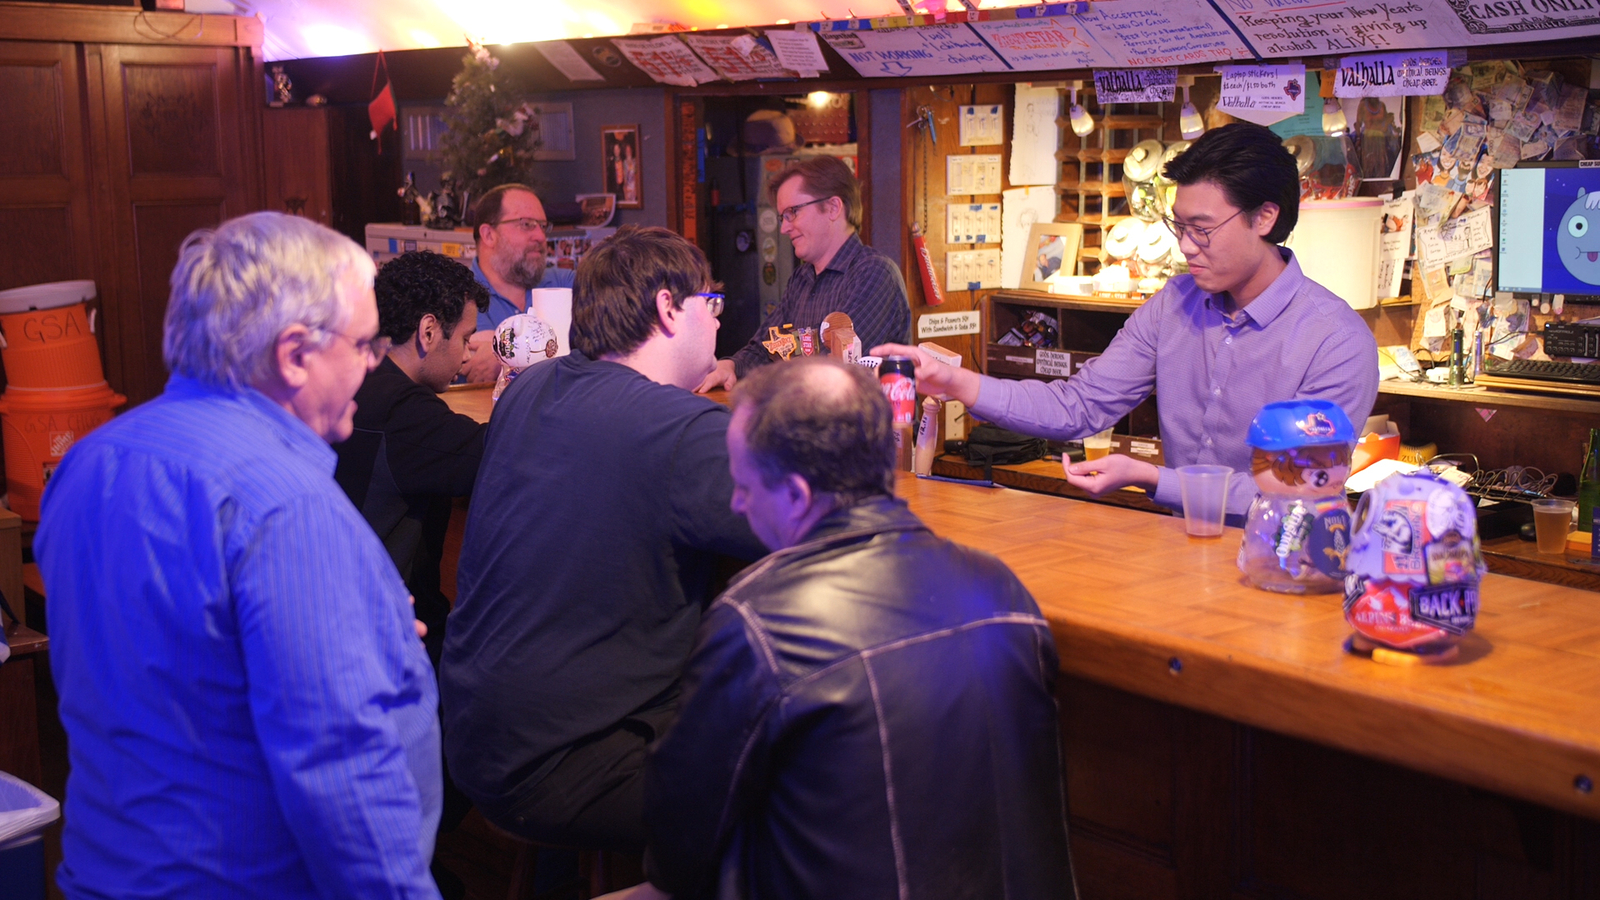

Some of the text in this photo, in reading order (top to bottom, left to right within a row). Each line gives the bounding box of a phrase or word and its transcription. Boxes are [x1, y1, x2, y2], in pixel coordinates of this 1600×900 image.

[1239, 14, 1313, 29] Keeping
[1311, 10, 1344, 25] your
[1344, 6, 1378, 20] New
[1469, 0, 1529, 20] CASH
[1254, 19, 1428, 41] resolution of giving up
[1267, 40, 1317, 54] alcohol
[1326, 34, 1391, 51] ALIVE!
[849, 48, 934, 64] NOT WORKING
[1127, 57, 1145, 67] NO
[1145, 55, 1172, 64] CREDIT
[1175, 50, 1207, 62] CARDS
[1226, 71, 1247, 81] Laptop
[1260, 81, 1277, 90] both
[23, 311, 82, 344] GSA
[1419, 589, 1462, 618] BACK
